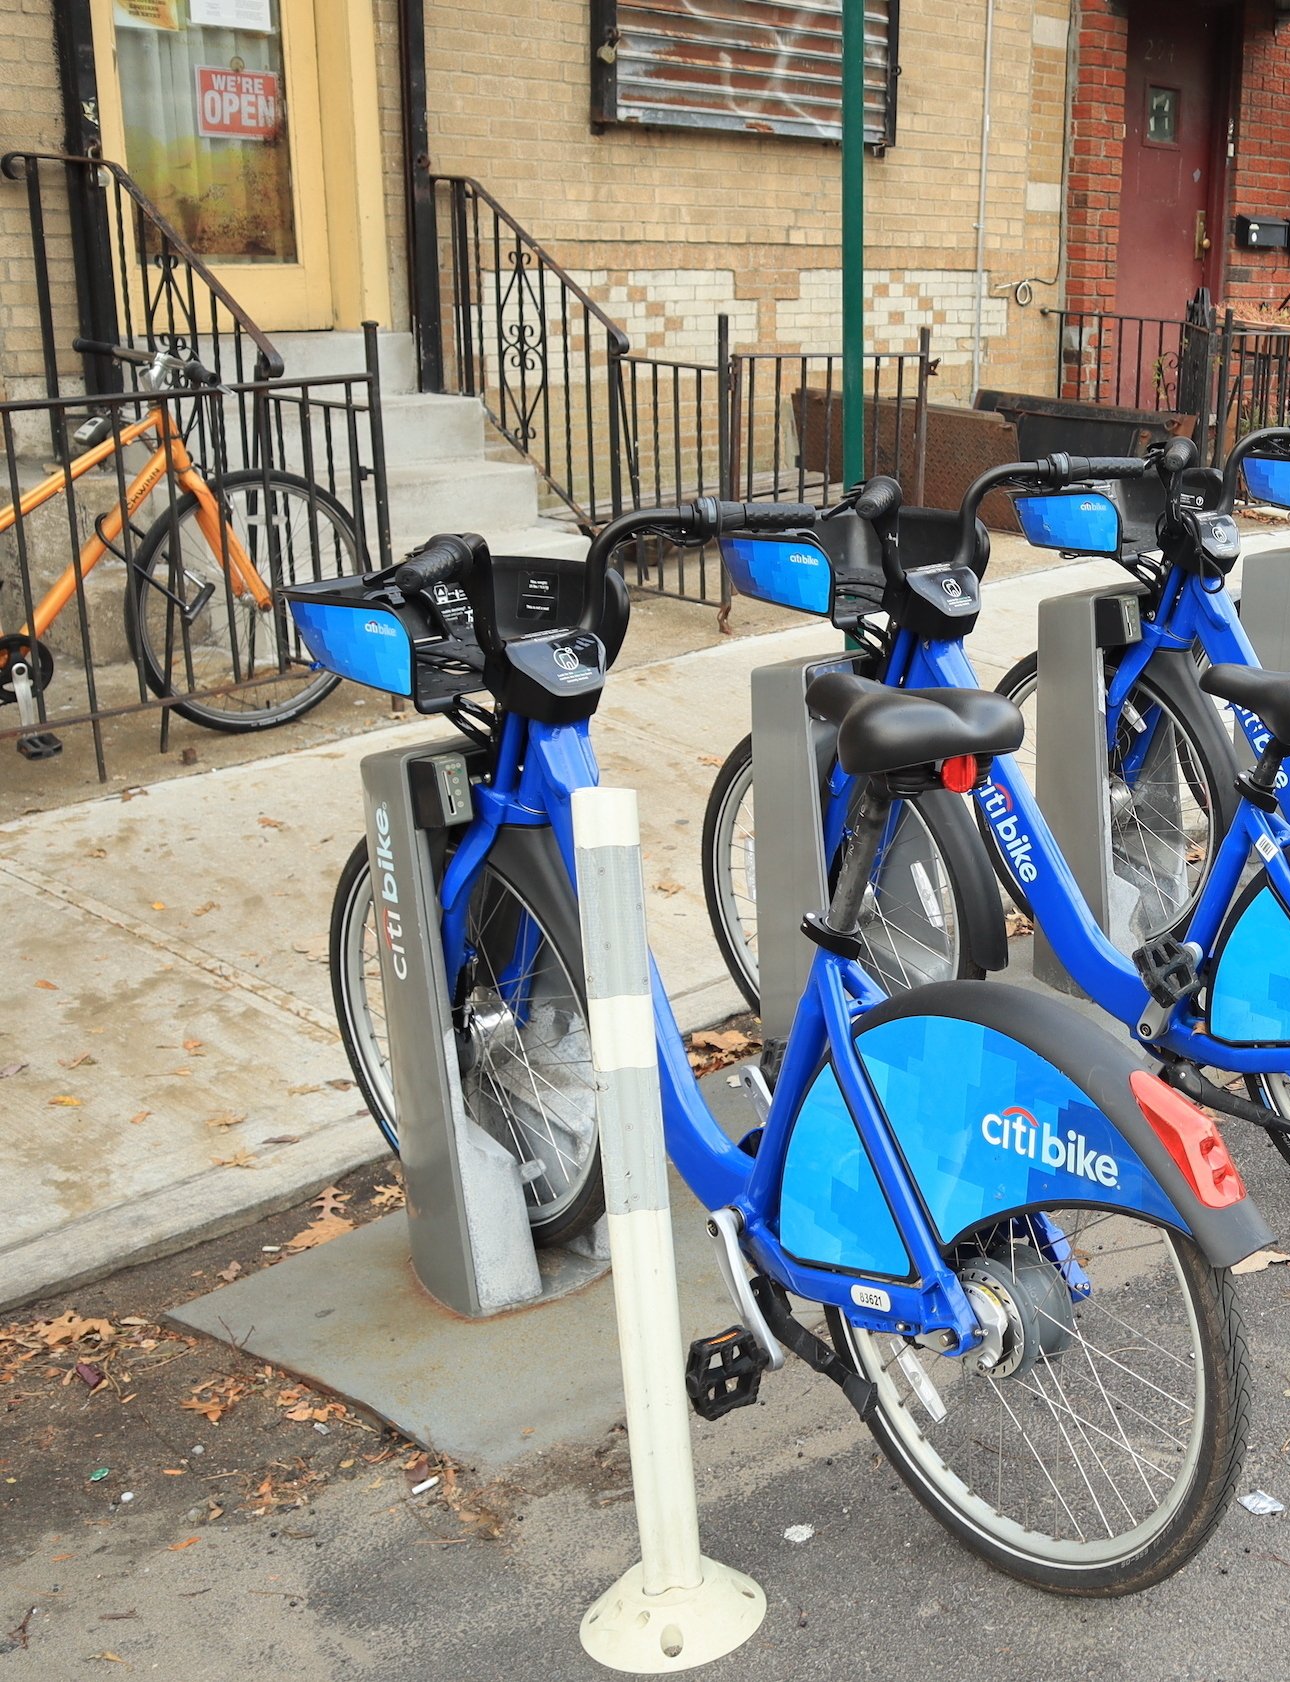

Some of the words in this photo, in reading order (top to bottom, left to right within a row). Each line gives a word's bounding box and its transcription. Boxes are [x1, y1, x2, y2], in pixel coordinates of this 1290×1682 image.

[211, 73, 265, 95] WE'RE
[204, 90, 276, 128] OPEN
[127, 467, 160, 511] CHWINN
[1080, 502, 1091, 511] citi
[1091, 503, 1107, 512] bike
[789, 552, 802, 564] citi
[802, 554, 819, 566] bike
[364, 620, 378, 634] citi
[379, 623, 397, 637] bike
[978, 776, 1014, 819] iti
[996, 815, 1038, 884] bike
[375, 806, 400, 904] bike
[383, 906, 408, 981] citi
[981, 1106, 1040, 1160] citi
[1041, 1121, 1121, 1189] bike
[859, 1291, 883, 1307] 83621
